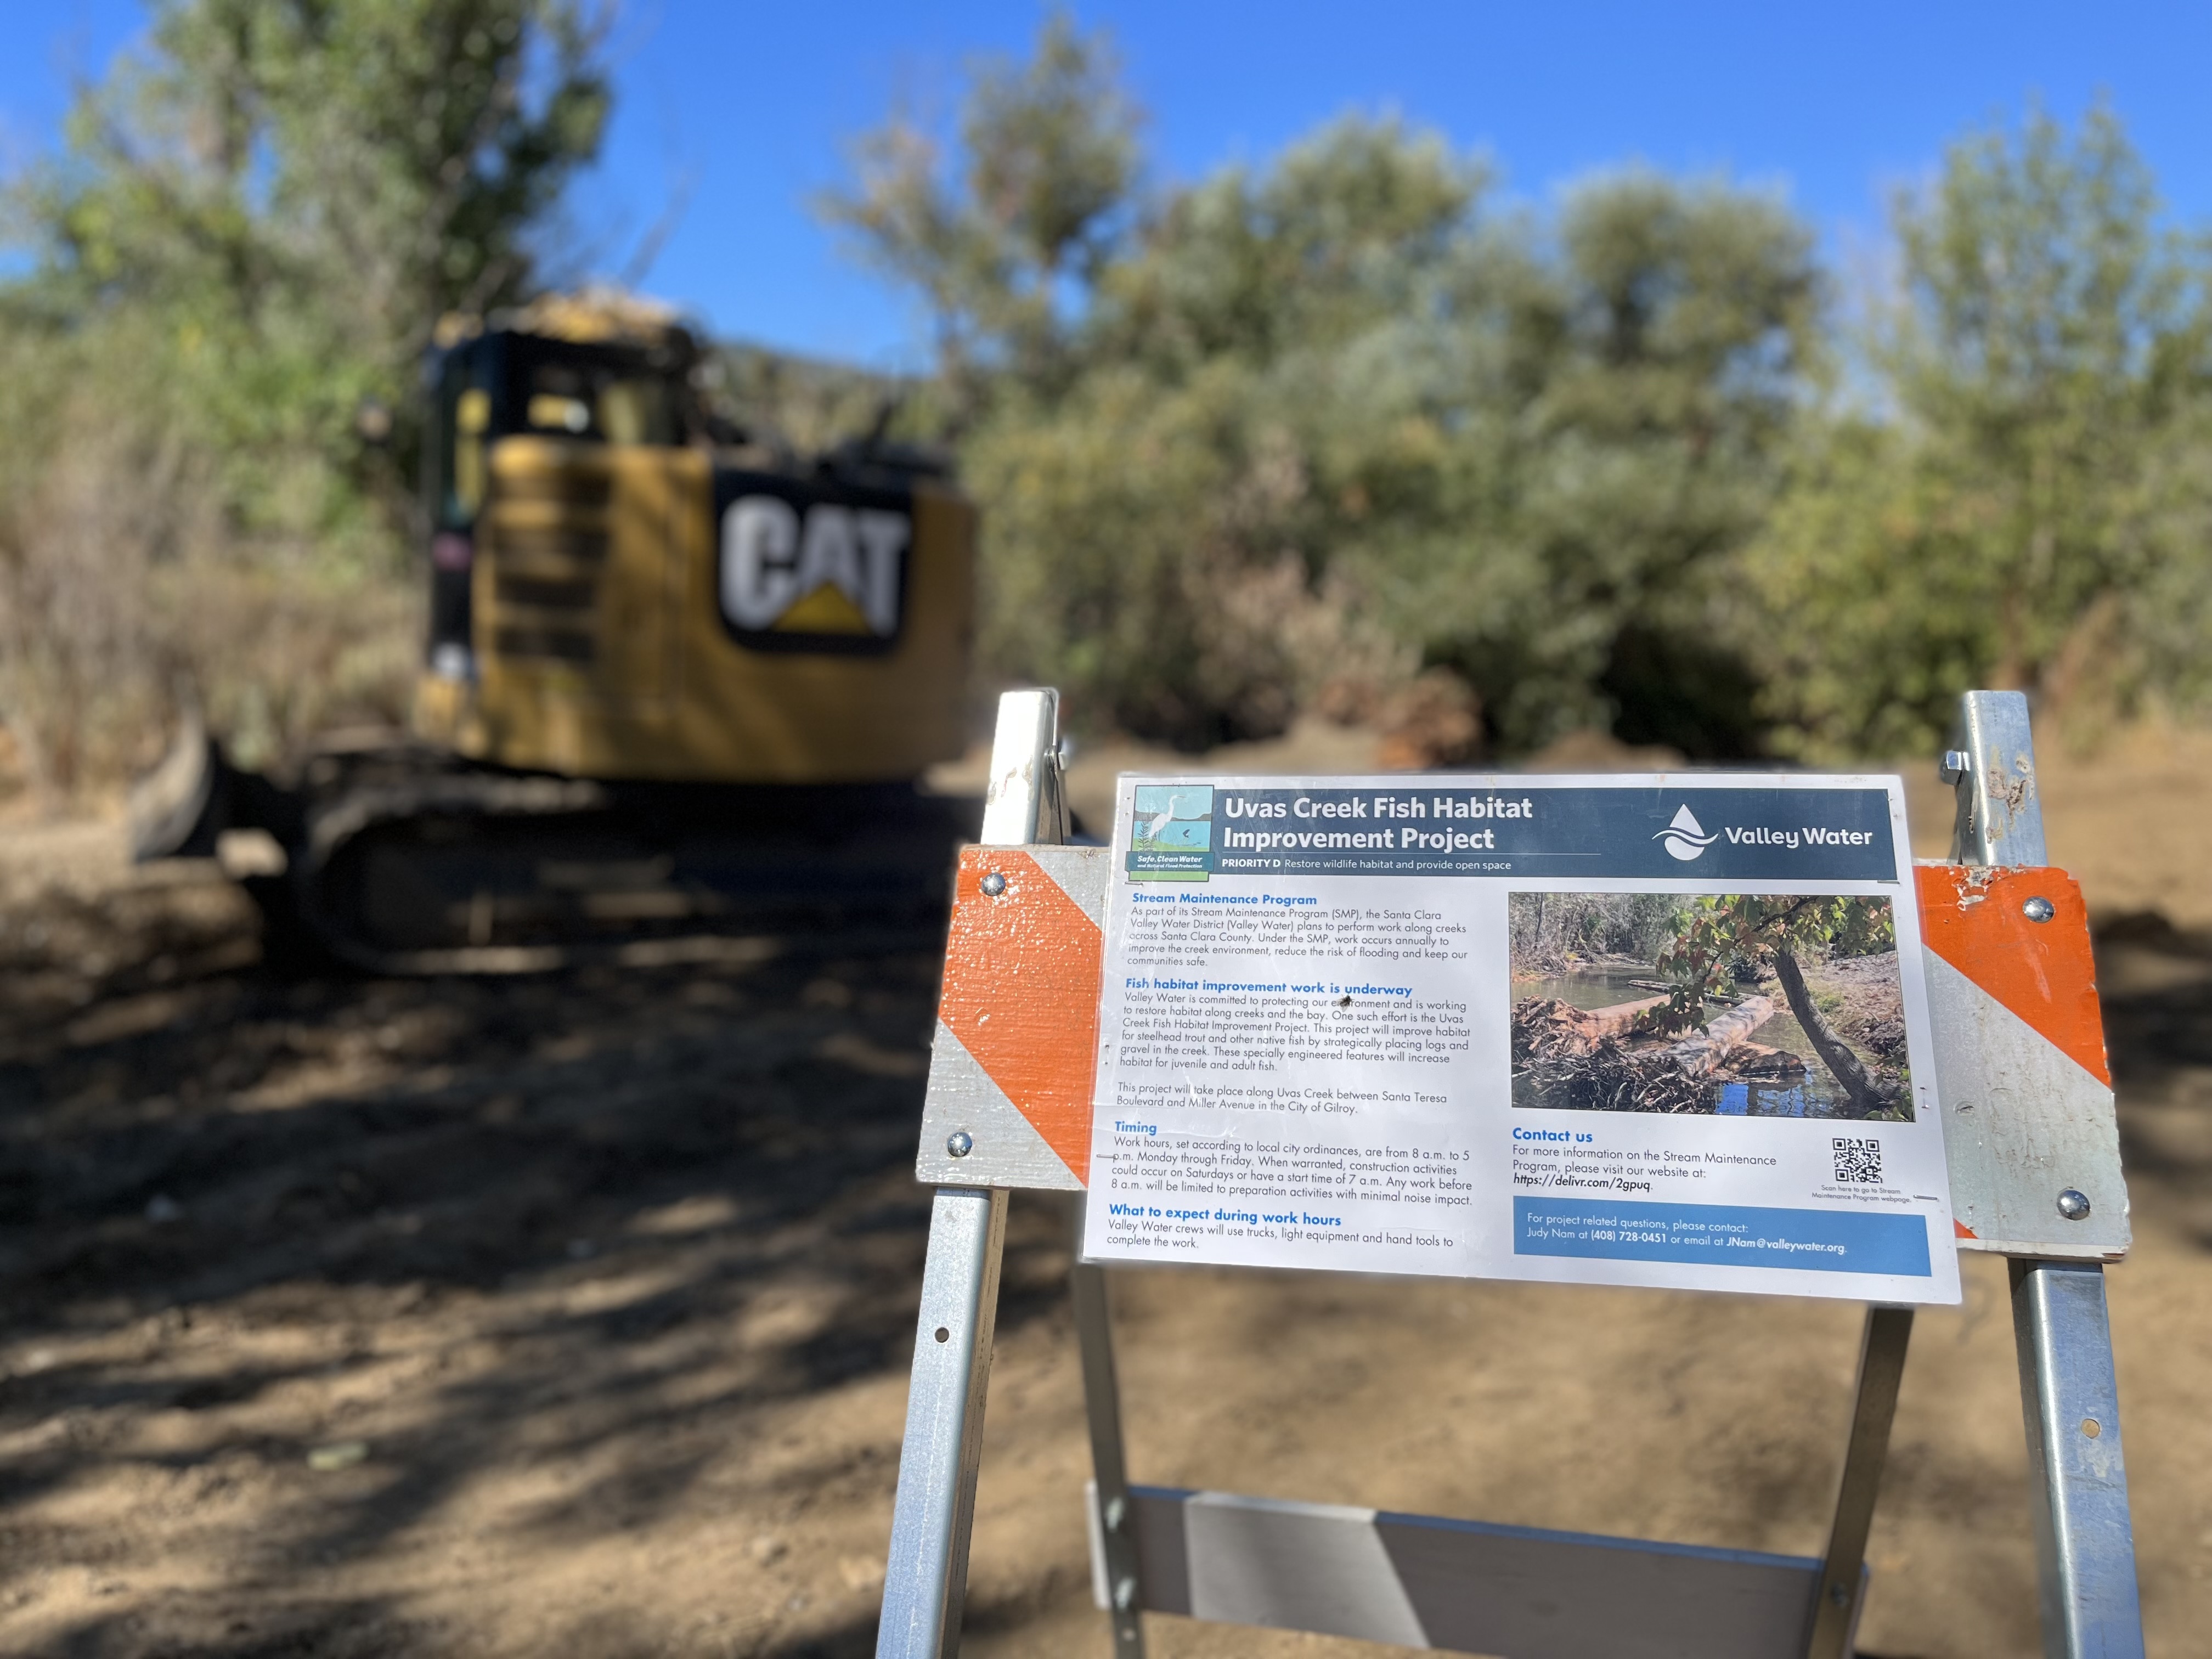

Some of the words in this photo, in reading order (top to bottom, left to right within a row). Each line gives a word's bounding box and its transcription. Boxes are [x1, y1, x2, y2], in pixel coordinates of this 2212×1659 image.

[721, 495, 912, 636] CAT
[1226, 798, 1287, 818] Uvas
[1294, 797, 1367, 818] Creek
[1374, 797, 1426, 818] Fish
[1434, 797, 1533, 819] Habitat
[1224, 827, 1394, 852] Improvement
[1402, 827, 1494, 853] Project
[1725, 827, 1799, 849] Valley
[1802, 827, 1873, 845] Water
[1222, 859, 1271, 867] PRIORITY
[1273, 859, 1281, 867] D
[1285, 859, 1321, 868] Restore
[1323, 860, 1357, 868] wildlife
[1360, 859, 1393, 868] habitat
[1396, 860, 1414, 868] and
[1417, 860, 1453, 871] provide
[1455, 862, 1480, 871] open
[1483, 863, 1511, 871] space
[1132, 893, 1176, 903] Stream
[1180, 893, 1259, 904] Maintenance
[1262, 895, 1317, 907] Program
[1131, 906, 1143, 915] As
[1146, 908, 1164, 917] part
[1166, 906, 1177, 916] of
[1179, 907, 1189, 916] its
[1192, 907, 1223, 916] Stream
[1226, 907, 1286, 917] Maintenance
[1289, 909, 1329, 920] Program
[1332, 909, 1363, 921] (SMP),
[1366, 909, 1381, 918] the
[1384, 909, 1412, 919] Santa
[1414, 909, 1442, 920] Clara
[1131, 918, 1159, 930] Valley
[1161, 918, 1190, 928] Water
[1193, 919, 1224, 929] District
[1227, 919, 1259, 932] (Valley
[1261, 921, 1294, 932] Water)
[1297, 920, 1323, 933] plans
[1325, 922, 1335, 930] to
[1338, 921, 1375, 934] perform
[1378, 922, 1402, 932] work
[1404, 922, 1432, 935] along
[1435, 923, 1467, 933] creeks
[1127, 957, 1183, 965] communities
[1186, 956, 1208, 966] safe.
[1126, 978, 1149, 988] Fish
[1154, 978, 1199, 990] habitat
[1203, 980, 1288, 994] improvement
[1291, 982, 1325, 993] work
[1330, 983, 1340, 994] is
[1345, 983, 1413, 998] underway
[1120, 1043, 1150, 1056] gravel
[1153, 1045, 1162, 1054] in
[1165, 1044, 1179, 1054] the
[1182, 1045, 1210, 1056] creek.
[1214, 1046, 1240, 1056] These
[1244, 1047, 1285, 1060] specially
[1288, 1049, 1343, 1061] engineered
[1346, 1050, 1385, 1061] features
[1387, 1052, 1405, 1062] will
[1408, 1053, 1450, 1063] increase
[1119, 1082, 1136, 1092] This
[1138, 1084, 1172, 1096] project
[1175, 1085, 1191, 1093] will
[1194, 1085, 1214, 1095] take
[1217, 1086, 1244, 1098] place
[1246, 1087, 1274, 1099] along
[1277, 1087, 1301, 1098] Uvas
[1304, 1088, 1334, 1098] Creek
[1337, 1090, 1379, 1101] between
[1382, 1091, 1411, 1102] Santa
[1414, 1092, 1447, 1103] Teresa
[1117, 1095, 1164, 1106] Boulevard
[1167, 1097, 1186, 1107] and
[1189, 1098, 1217, 1108] Miller
[1219, 1099, 1255, 1110] Avenue
[1259, 1101, 1267, 1110] in
[1271, 1101, 1285, 1110] the
[1288, 1101, 1308, 1114] City
[1311, 1102, 1322, 1111] of
[1323, 1103, 1358, 1116] Gilroy.
[1115, 1121, 1158, 1136] Timing
[1513, 1128, 1571, 1142] Contact
[1576, 1135, 1593, 1143] us
[1513, 1145, 1530, 1155] For
[1564, 1147, 1623, 1159] information
[1644, 1150, 1660, 1160] the
[1664, 1150, 1701, 1162] Stream
[1705, 1153, 1776, 1165] Maintenance
[1514, 1161, 1560, 1173] Program,
[1565, 1163, 1599, 1175] please
[1603, 1164, 1623, 1175] visit
[1648, 1166, 1689, 1177] website
[1693, 1169, 1706, 1178] at:
[1514, 1173, 1653, 1193] https://delivr.com/2gpuq.
[1853, 1194, 1880, 1202] Program
[1109, 1204, 1145, 1216] What
[1149, 1206, 1162, 1217] to
[1165, 1210, 1210, 1222] expect
[1214, 1209, 1258, 1225] during
[1262, 1212, 1299, 1224] work
[1303, 1212, 1342, 1226] hours
[1528, 1213, 1543, 1223] For
[1547, 1215, 1581, 1227] project
[1583, 1216, 1617, 1226] related
[1621, 1219, 1669, 1231] questions,
[1673, 1219, 1706, 1232] please
[1709, 1224, 1748, 1233] contact:
[1107, 1235, 1151, 1248] complete
[1154, 1236, 1169, 1246] the
[1172, 1238, 1199, 1249] work.
[1108, 1220, 1139, 1233] Valley
[1141, 1222, 1173, 1232] Water
[1207, 1225, 1224, 1235] will
[1247, 1227, 1278, 1239] trucks,
[1282, 1228, 1304, 1242] light
[1306, 1231, 1360, 1243] equipment
[1362, 1233, 1383, 1243] and
[1386, 1233, 1413, 1245] hand
[1416, 1235, 1440, 1246] tools
[1443, 1238, 1454, 1247] to
[1527, 1227, 1549, 1239] Judy
[1552, 1228, 1575, 1238] Nam
[1592, 1231, 1616, 1242] (408)
[1620, 1232, 1666, 1243] 728-0451
[1684, 1236, 1711, 1245] email
[1714, 1238, 1724, 1246] at
[1726, 1237, 1847, 1255] JNam@valleywater.org.
